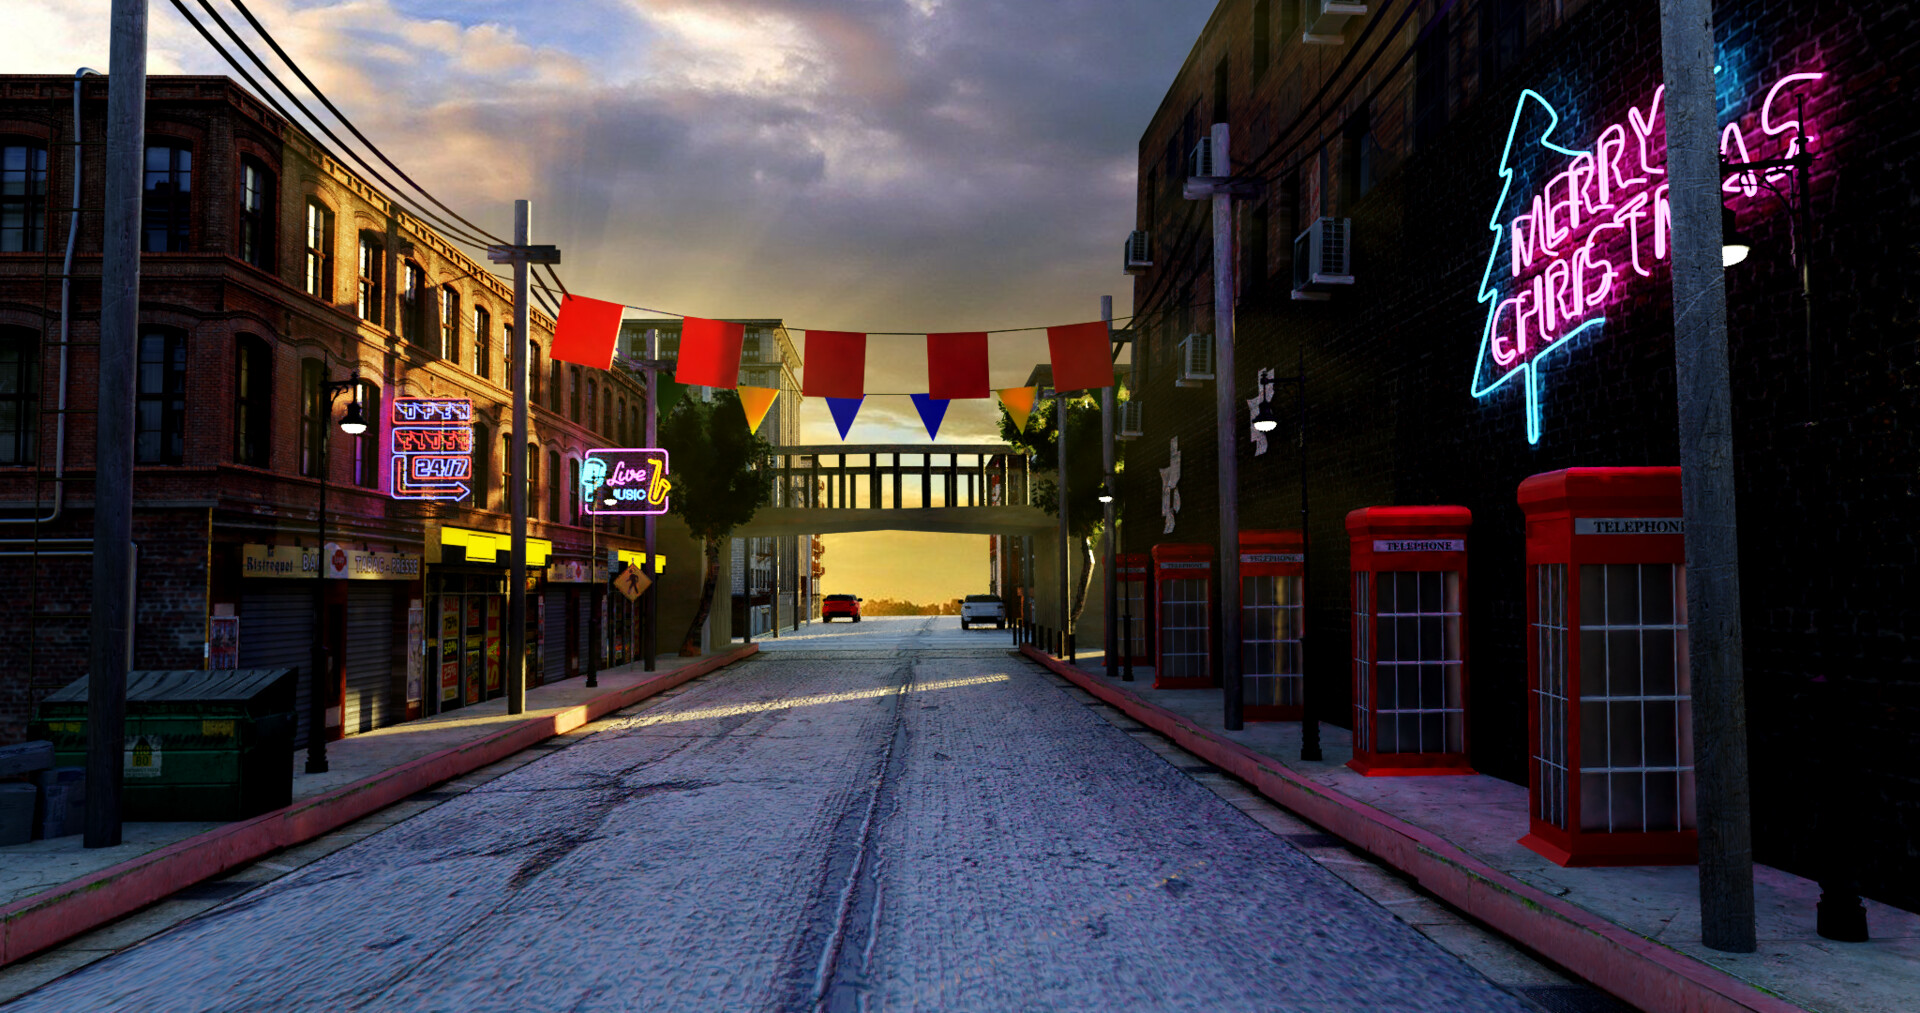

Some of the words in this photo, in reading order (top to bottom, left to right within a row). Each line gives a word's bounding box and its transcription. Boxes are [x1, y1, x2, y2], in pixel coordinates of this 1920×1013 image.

[1491, 72, 1824, 367] CHRISTAS
[393, 401, 471, 420] OPEN
[415, 458, 469, 477] 24/7
[606, 460, 648, 487] Live
[1386, 540, 1454, 552] TELEPHONE
[354, 555, 386, 574] TABAC
[391, 557, 418, 575] PRESSE
[443, 597, 459, 612] SALE
[487, 596, 501, 687] SALE
